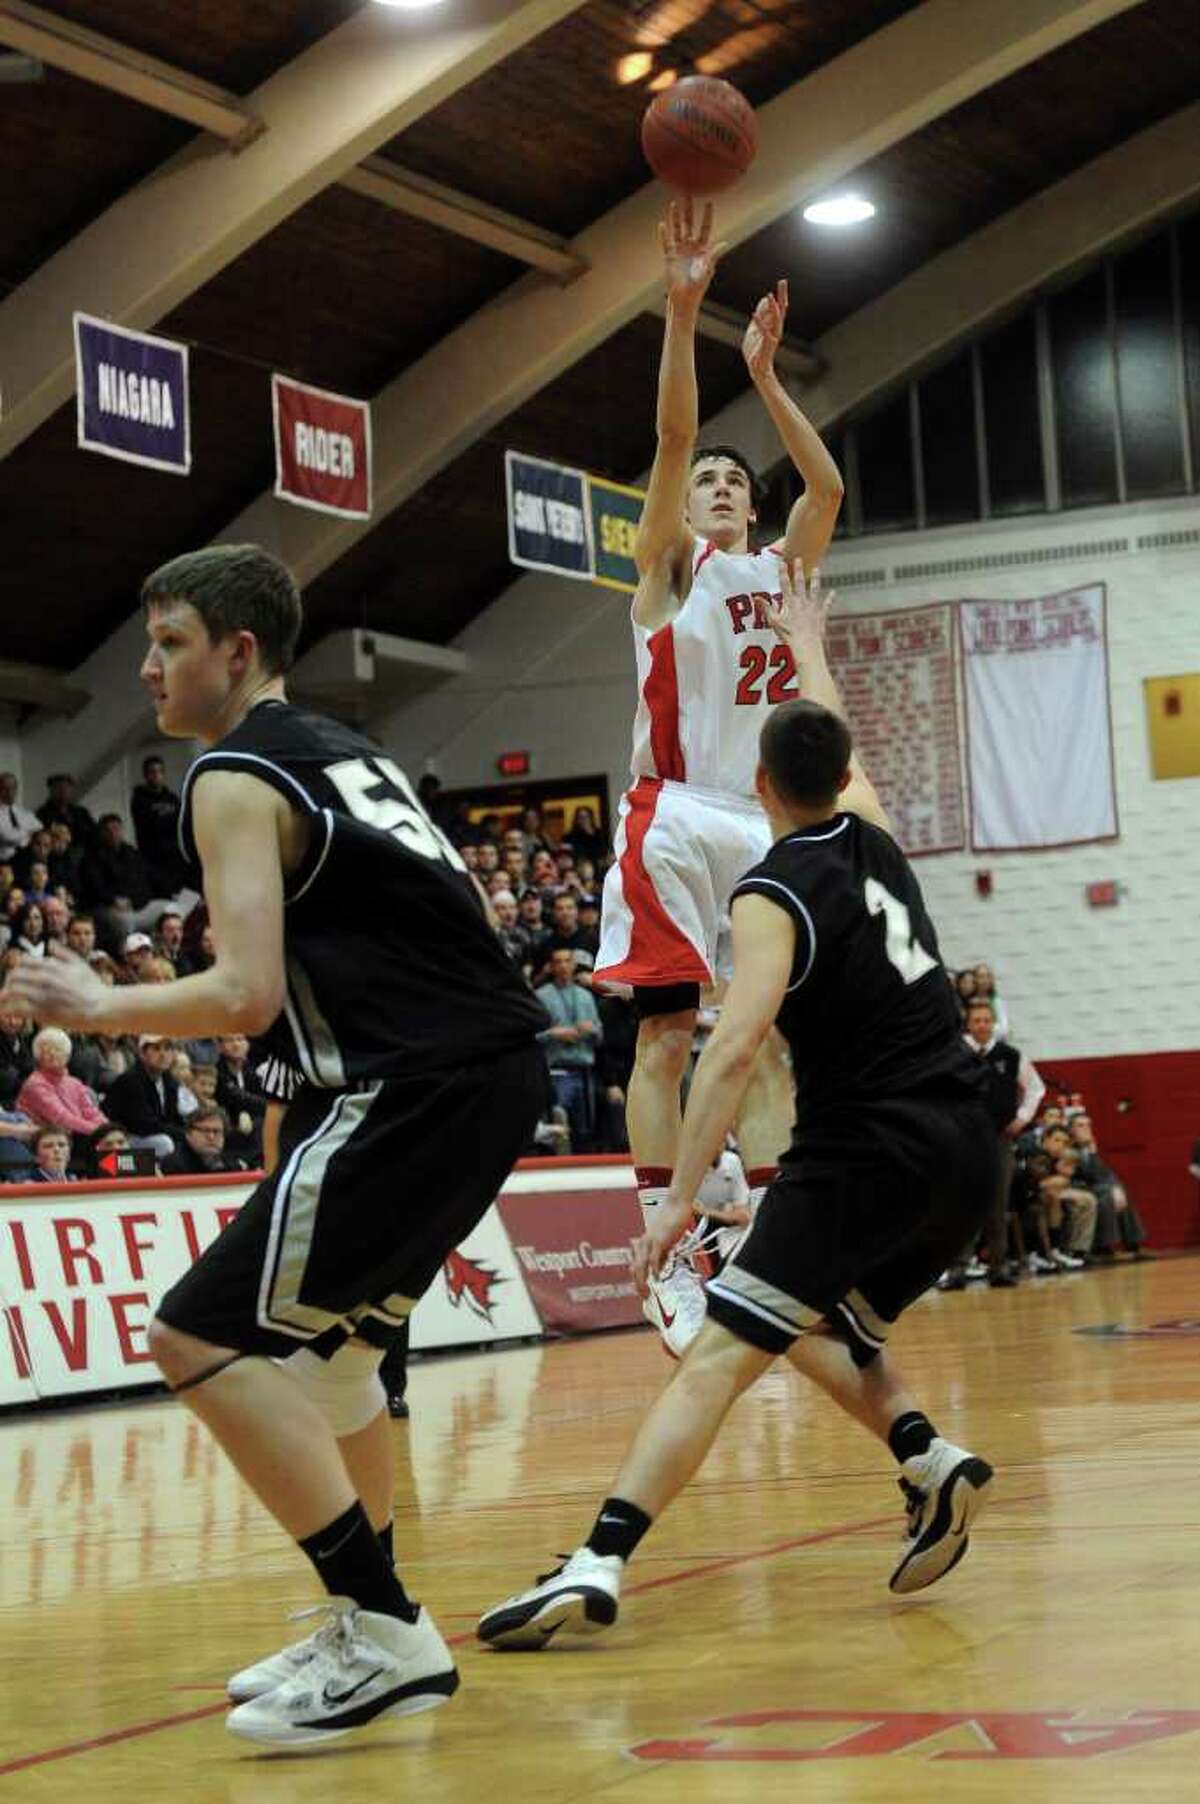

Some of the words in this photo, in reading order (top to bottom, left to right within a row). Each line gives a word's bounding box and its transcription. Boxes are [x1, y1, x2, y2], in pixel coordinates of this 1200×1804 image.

[98, 362, 175, 429] NIAGARA
[294, 422, 354, 479] RIDER
[734, 644, 800, 705] 22
[864, 876, 940, 985] 2
